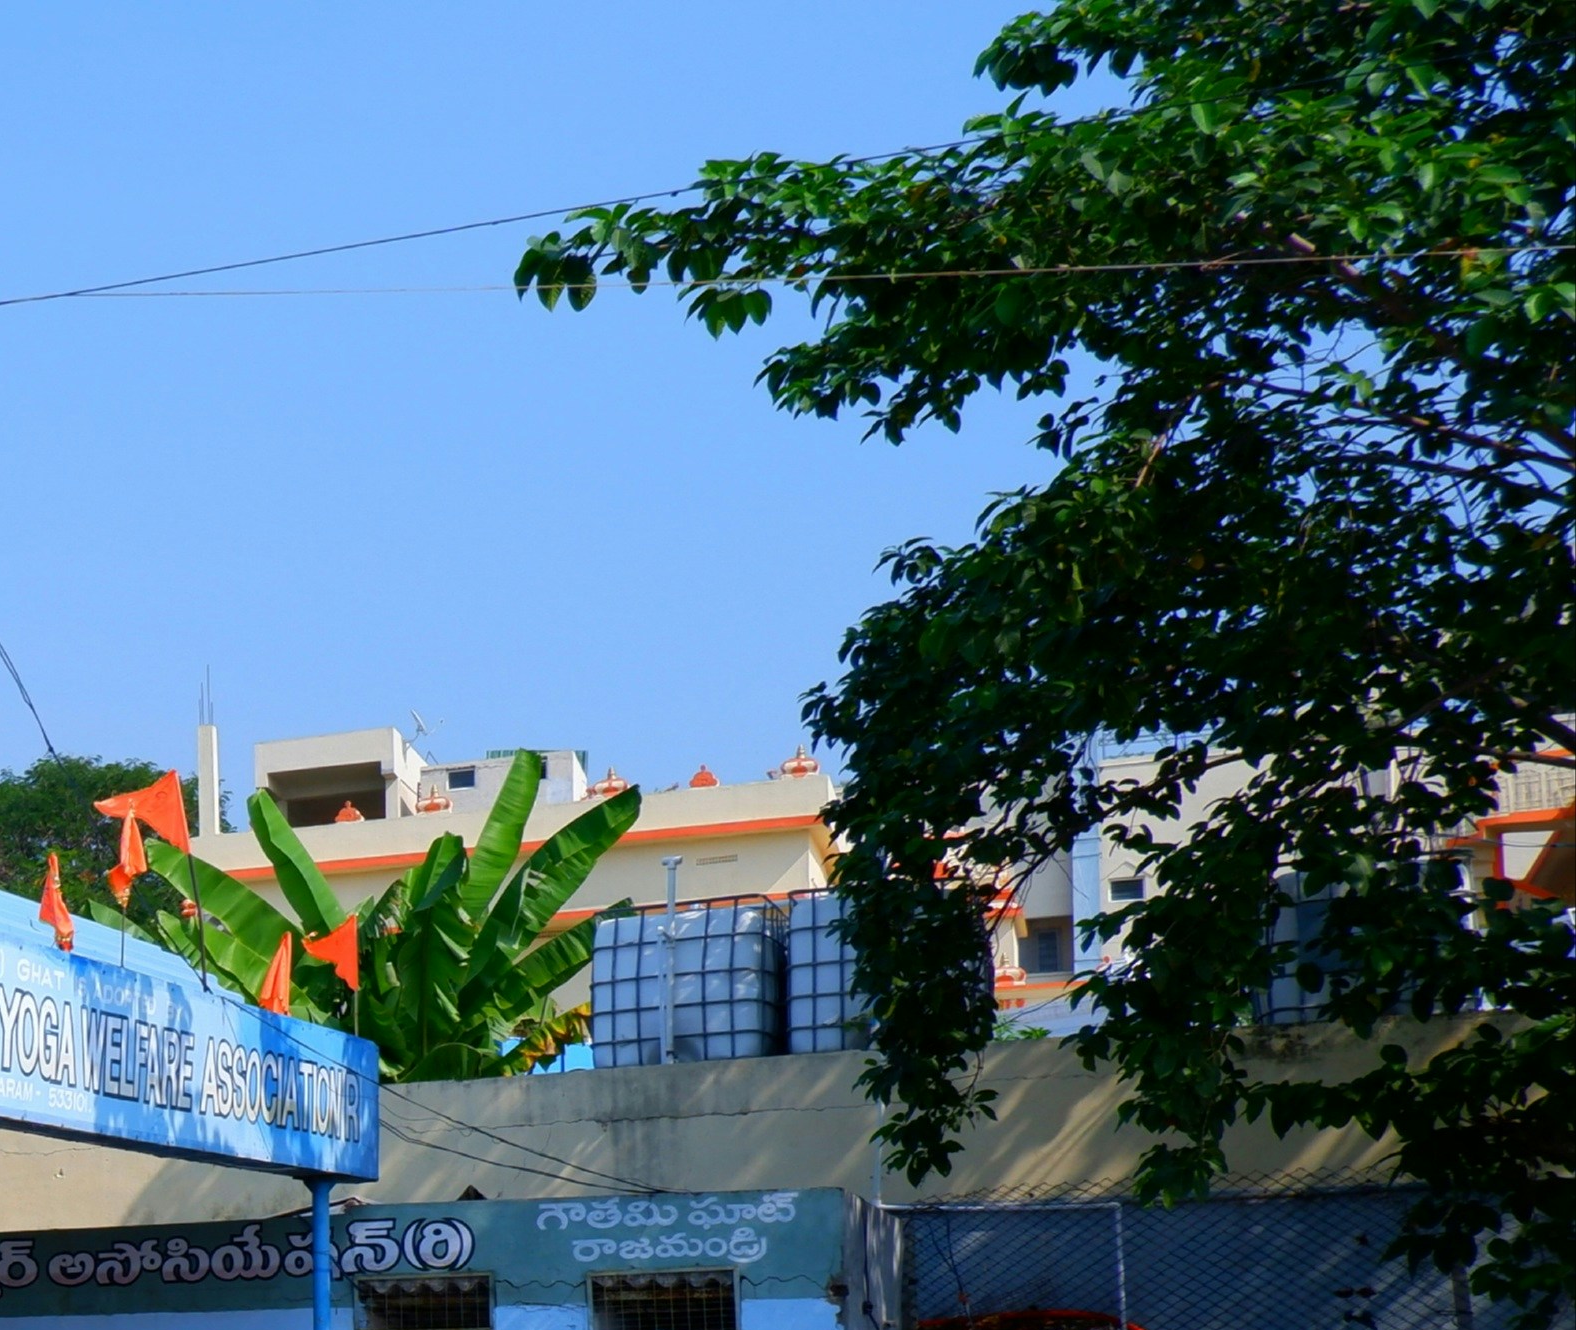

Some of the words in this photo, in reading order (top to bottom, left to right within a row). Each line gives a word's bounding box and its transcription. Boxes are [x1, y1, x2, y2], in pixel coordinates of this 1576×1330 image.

[16, 957, 66, 992] GHAT
[93, 975, 157, 1016] ADOPTED
[81, 1004, 195, 1114] WELFARE
[199, 1035, 346, 1141] ASSOCIATION
[536, 1199, 680, 1231] గౌతమి
[687, 1192, 799, 1230] ఘాట్
[572, 1226, 768, 1264] రాజమండ్రి
